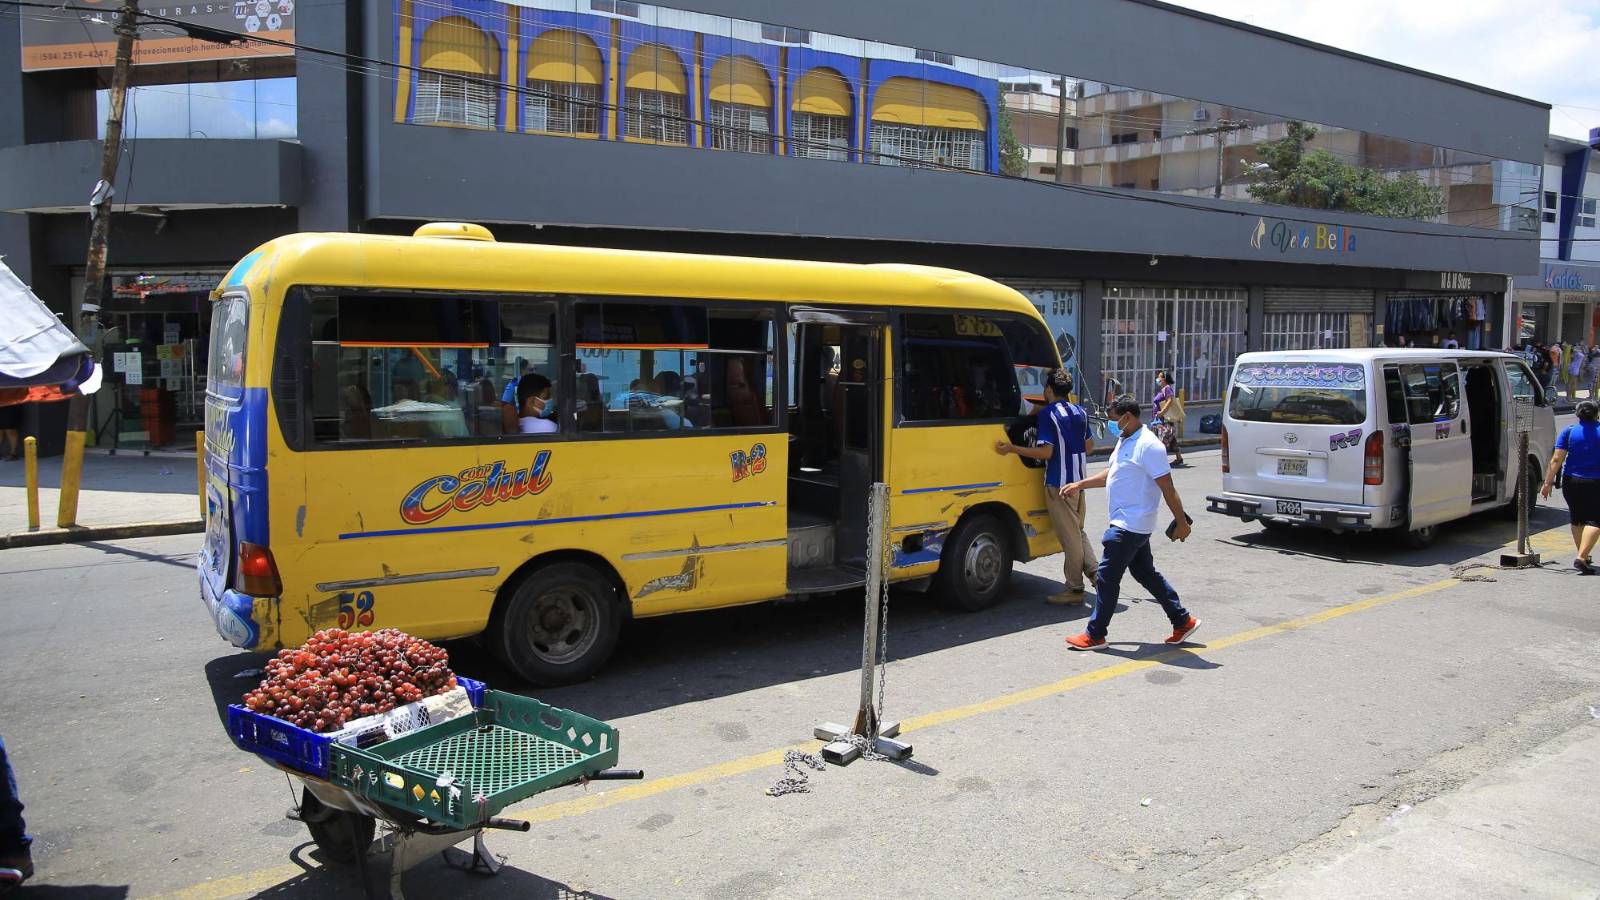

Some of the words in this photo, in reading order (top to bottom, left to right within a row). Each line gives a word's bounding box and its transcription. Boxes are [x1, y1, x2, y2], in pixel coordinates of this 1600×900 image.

[1316, 223, 1356, 252] Bella
[1440, 272, 1446, 289] M
[1452, 272, 1457, 289] M
[1458, 272, 1471, 290] Store
[1329, 428, 1363, 451] R-7
[729, 442, 767, 483] R-2
[399, 450, 553, 526] Cetul
[336, 590, 375, 630] 52
